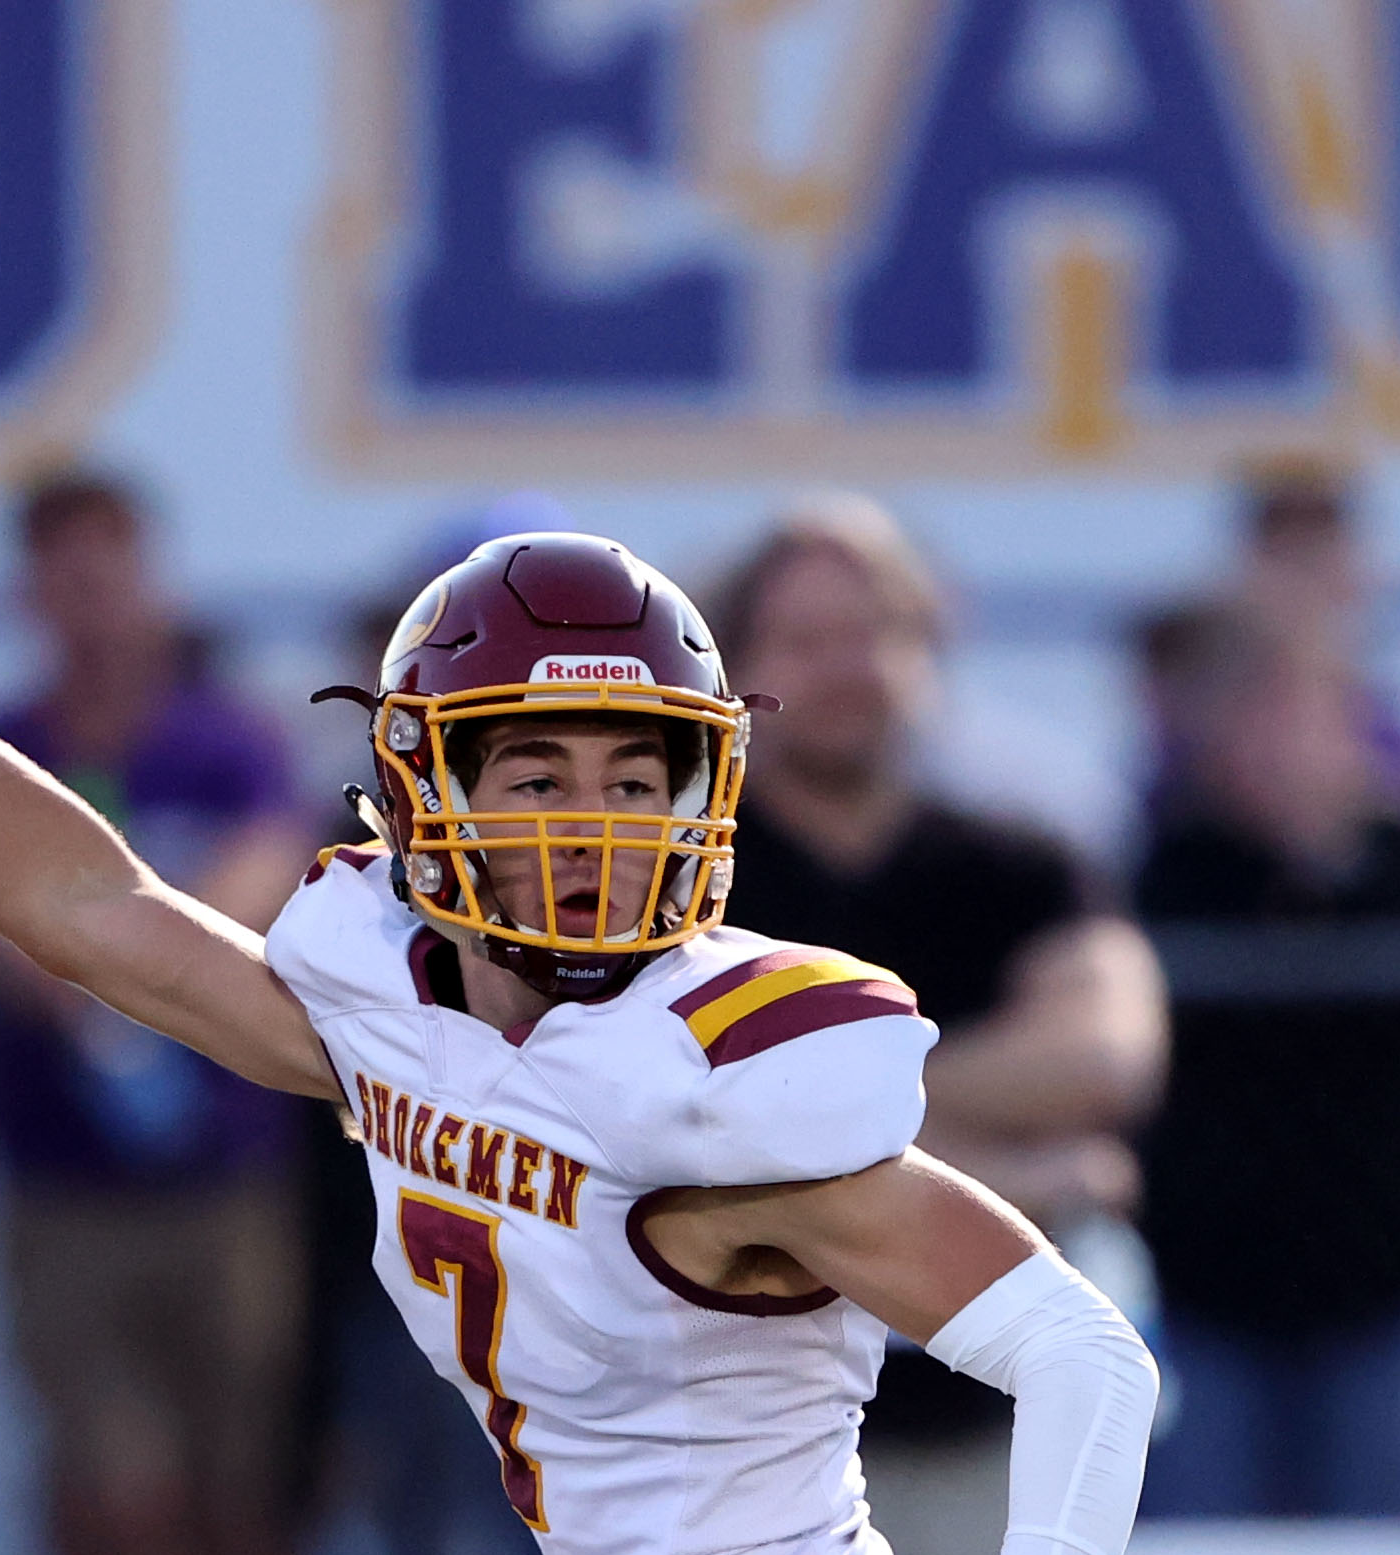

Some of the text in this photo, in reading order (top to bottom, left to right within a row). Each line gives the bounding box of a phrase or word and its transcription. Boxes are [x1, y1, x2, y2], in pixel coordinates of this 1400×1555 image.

[546, 662, 641, 680] Riddell
[556, 967, 605, 979] Riddell
[356, 1071, 589, 1229] SHOREMEN
[398, 1186, 550, 1533] 7
